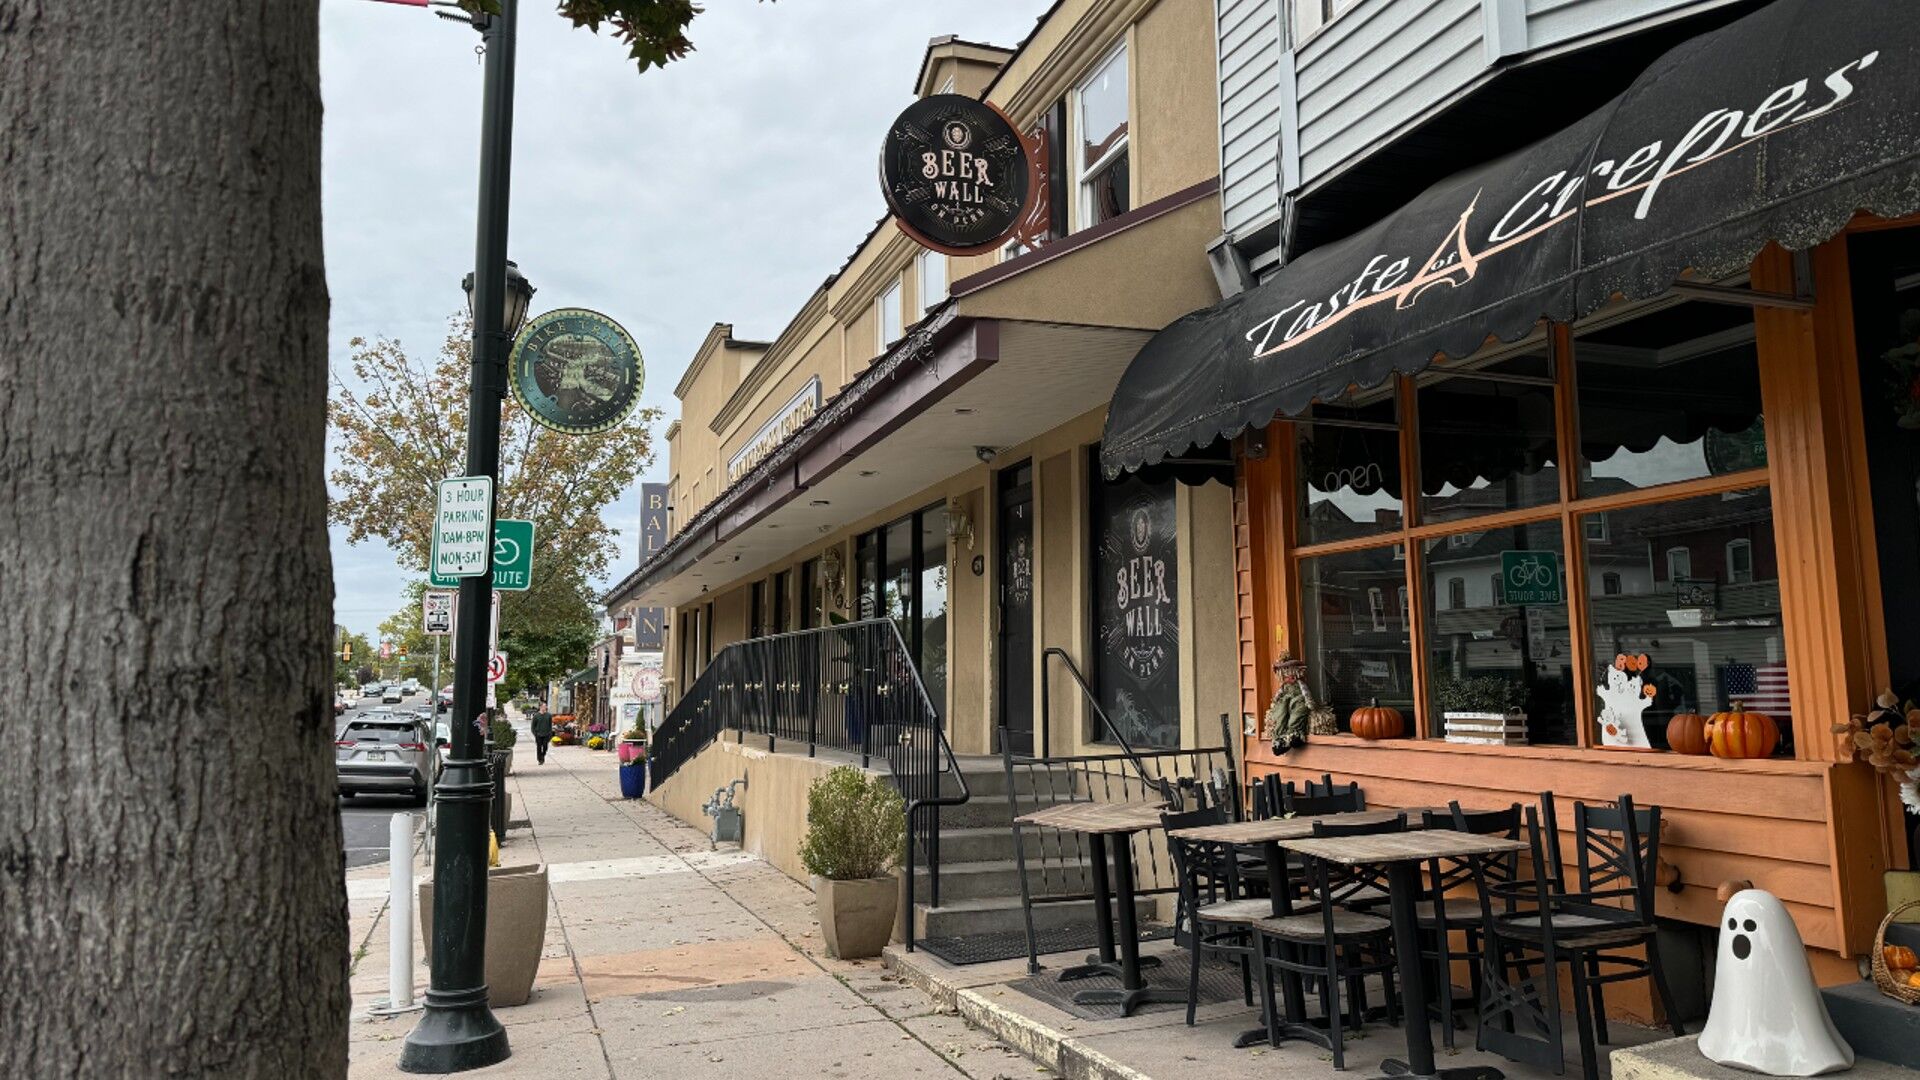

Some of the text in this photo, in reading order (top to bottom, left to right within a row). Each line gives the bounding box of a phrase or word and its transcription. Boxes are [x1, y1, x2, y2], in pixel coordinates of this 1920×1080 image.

[922, 150, 993, 187] BEER
[935, 181, 983, 203] WALL
[1246, 51, 1879, 357] Taste of Crepes
[528, 322, 565, 352] BIKE
[445, 489, 484, 502] 3 HOUR
[443, 509, 484, 523] PARKING
[441, 531, 485, 544] 10AM-8PM
[440, 551, 482, 565] MON-SAT
[493, 571, 523, 585] OUTE
[1117, 556, 1170, 609] BEER
[1126, 605, 1162, 637] WALL
